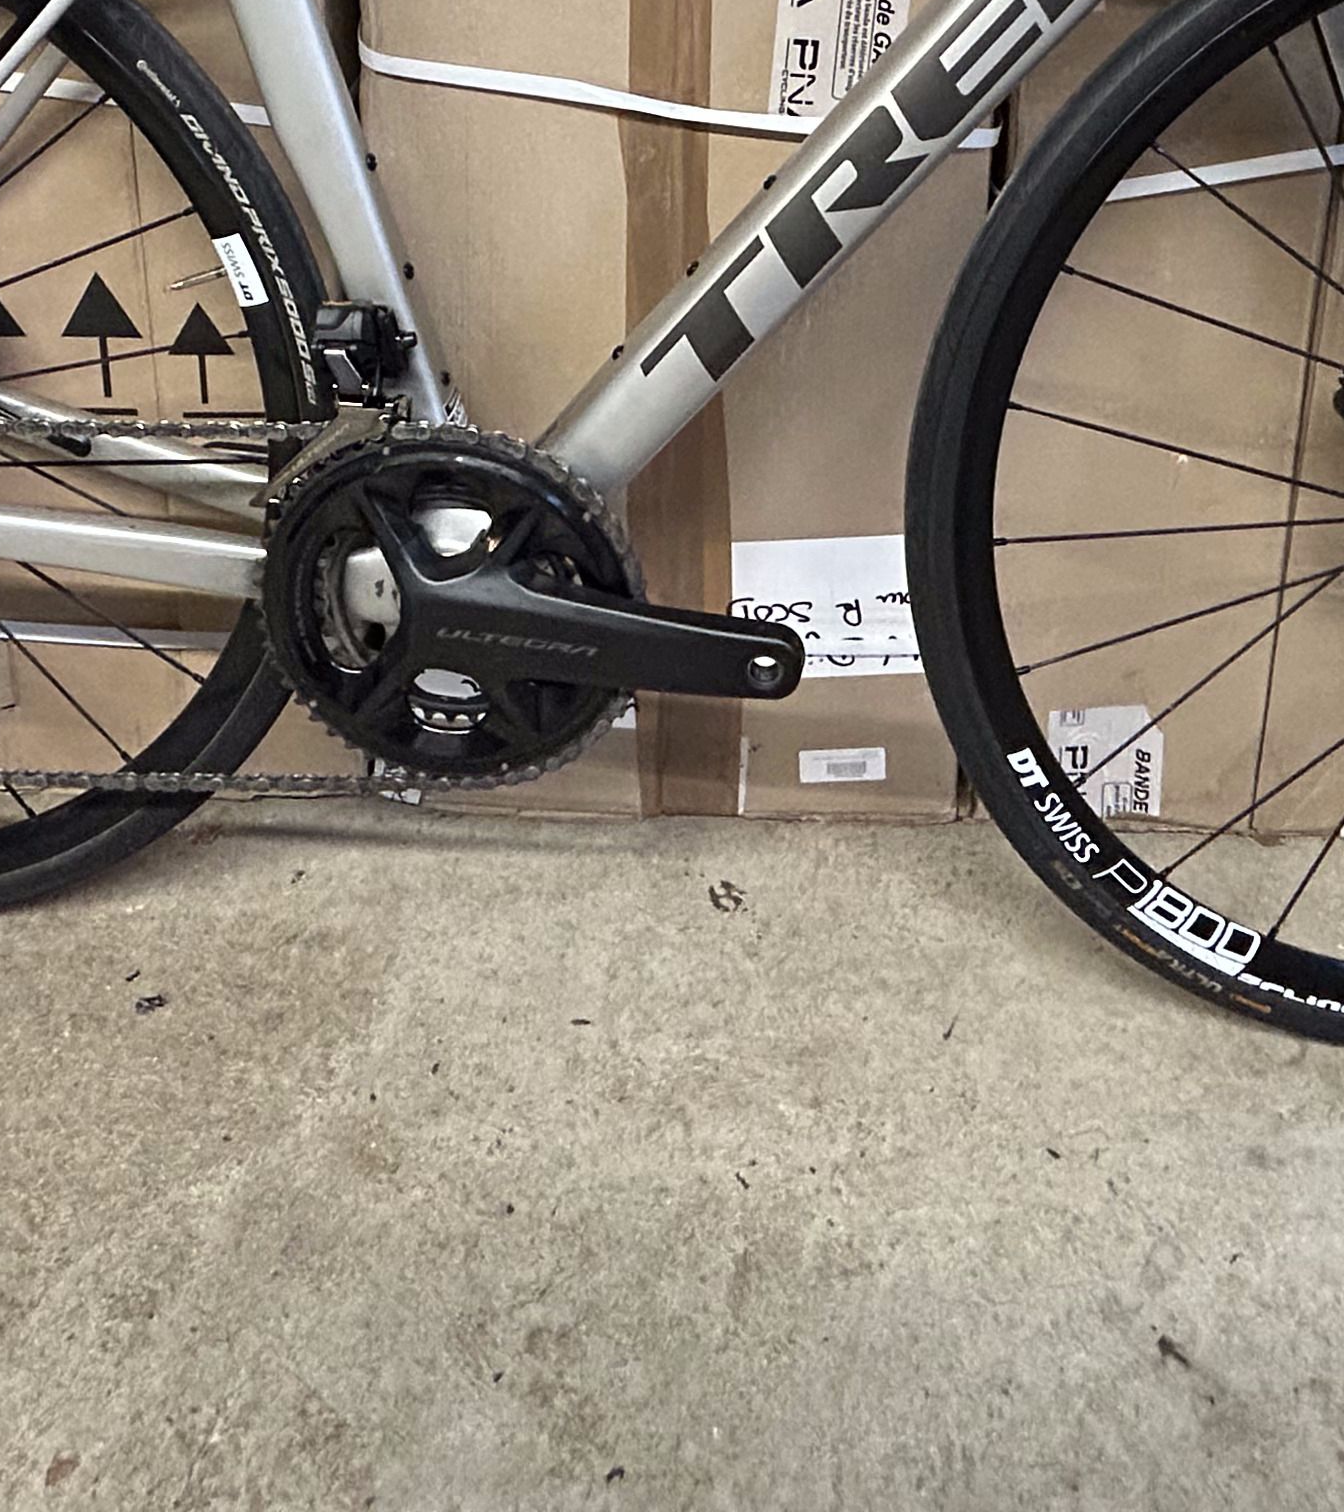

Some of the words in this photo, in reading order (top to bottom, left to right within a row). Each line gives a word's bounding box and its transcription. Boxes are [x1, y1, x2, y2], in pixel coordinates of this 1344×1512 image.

[221, 241, 246, 281] SWISS
[241, 205, 286, 277] PRIX
[274, 274, 312, 364] 5000
[238, 280, 254, 302] DT
[436, 627, 599, 657] ULTEGRA
[1006, 747, 1050, 791] DT
[1033, 792, 1100, 864] SWISS
[1133, 748, 1152, 815] BANDE
